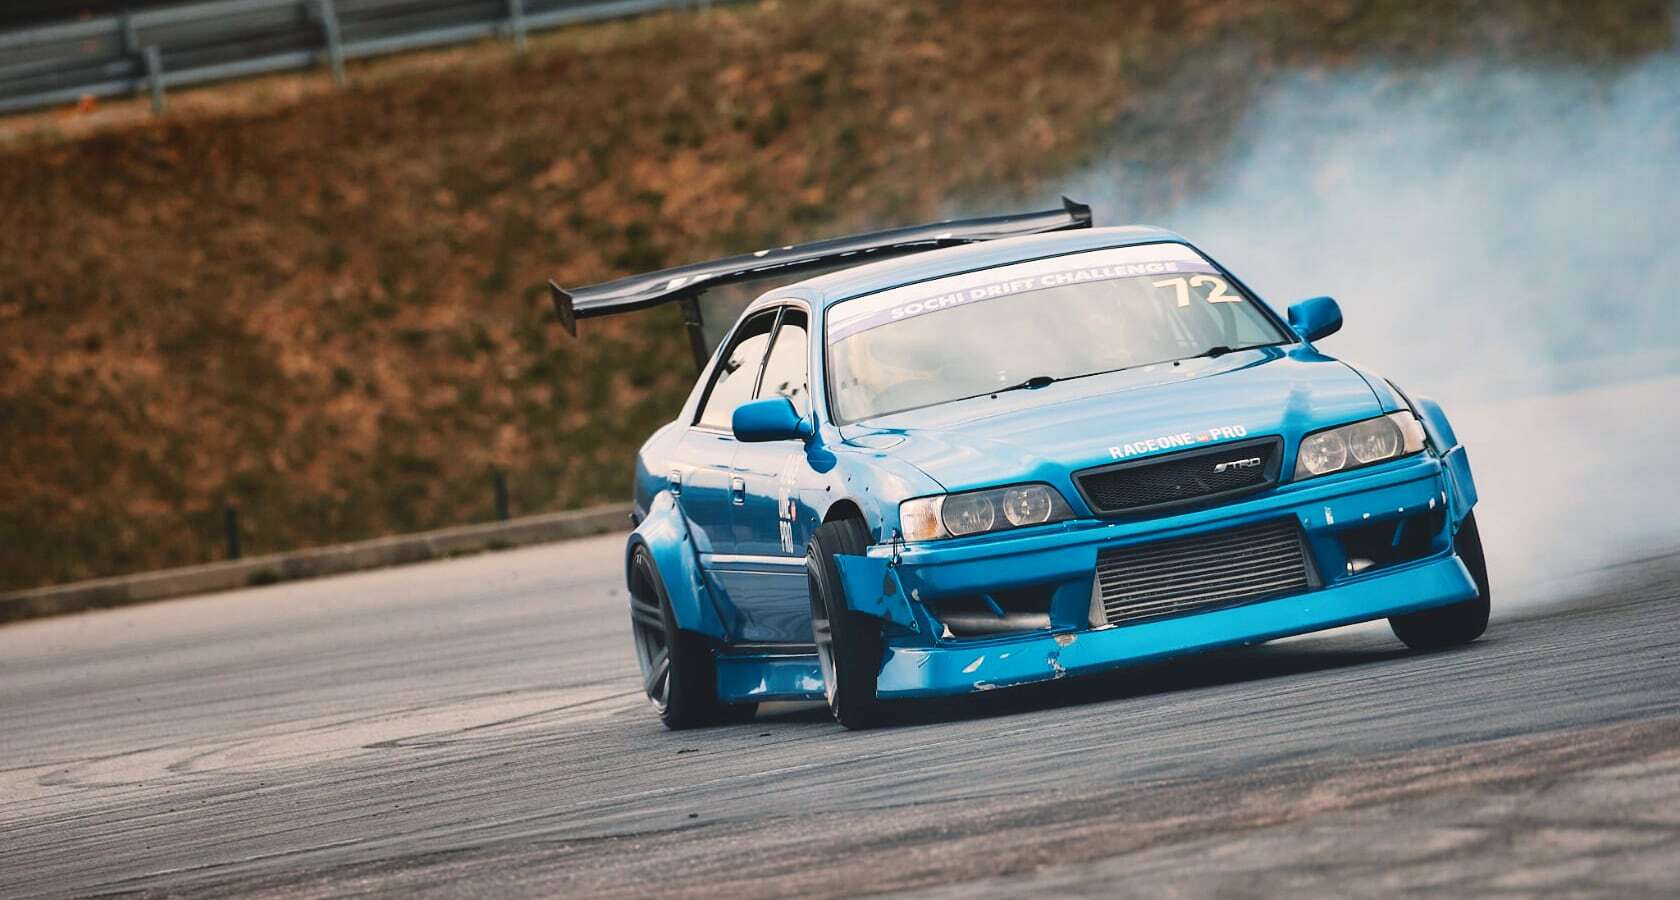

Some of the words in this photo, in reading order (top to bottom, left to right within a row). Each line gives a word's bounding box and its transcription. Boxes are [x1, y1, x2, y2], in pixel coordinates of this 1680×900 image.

[890, 291, 964, 320] SOCHI
[970, 279, 1034, 302] DRIFT
[1040, 261, 1179, 288] CHALLENGE
[1152, 274, 1242, 309] 72
[1108, 431, 1195, 460] RACEONE
[1208, 424, 1247, 441] PRO
